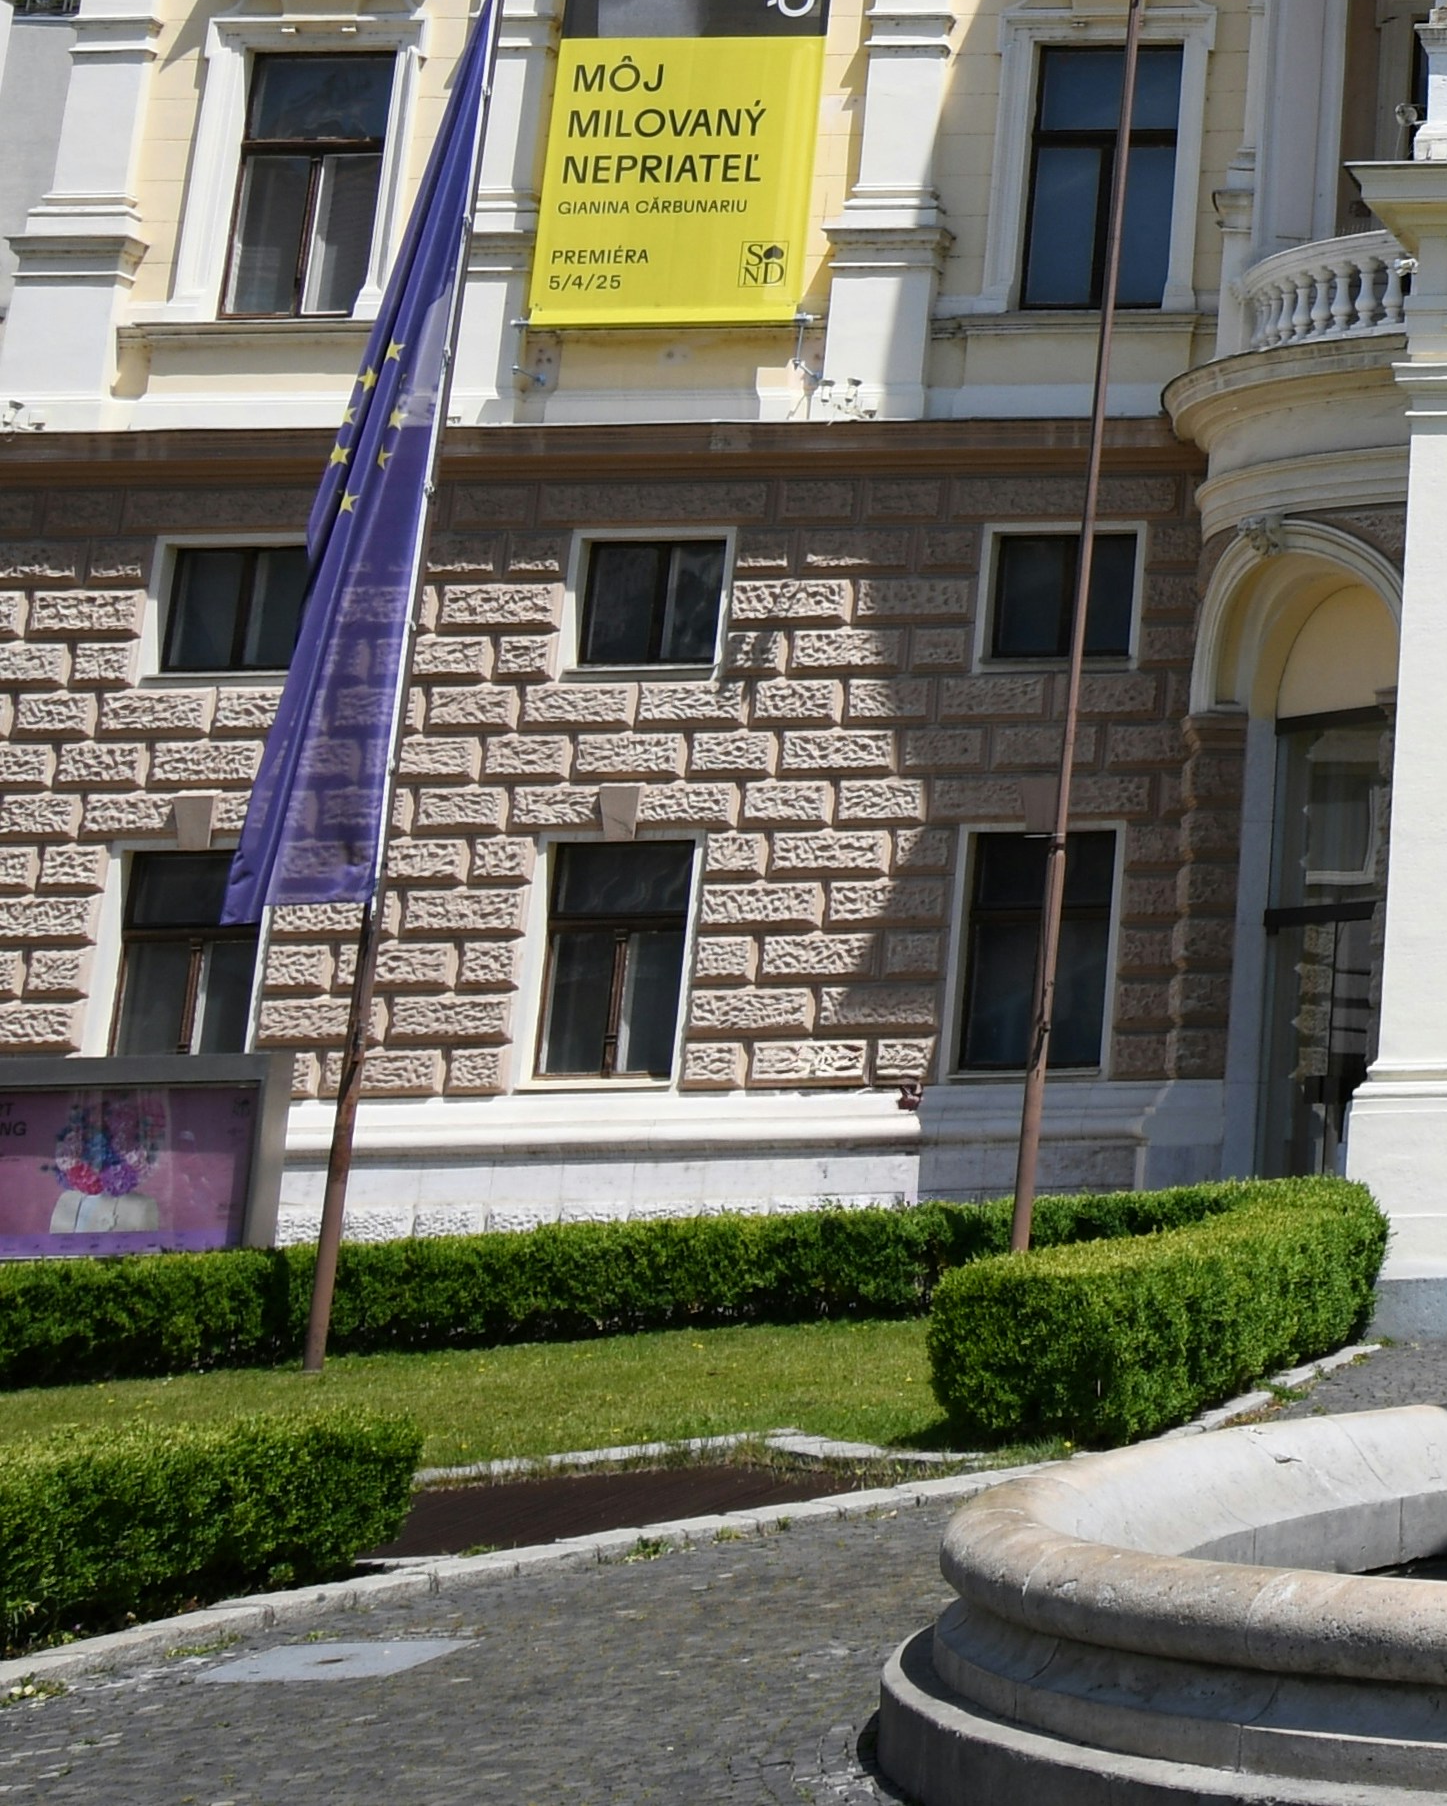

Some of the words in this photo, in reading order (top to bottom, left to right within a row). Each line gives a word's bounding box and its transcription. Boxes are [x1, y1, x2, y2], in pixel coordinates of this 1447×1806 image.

[572, 55, 665, 93] MÔJ
[567, 99, 767, 139] MILOVANÝ
[562, 153, 762, 185] NEPRIATEĽ
[557, 200, 630, 215] GIANINA
[635, 196, 748, 214] CĂRBUNARIU
[551, 244, 649, 265] PREMIÉRA
[548, 274, 622, 292] 5/4/25
